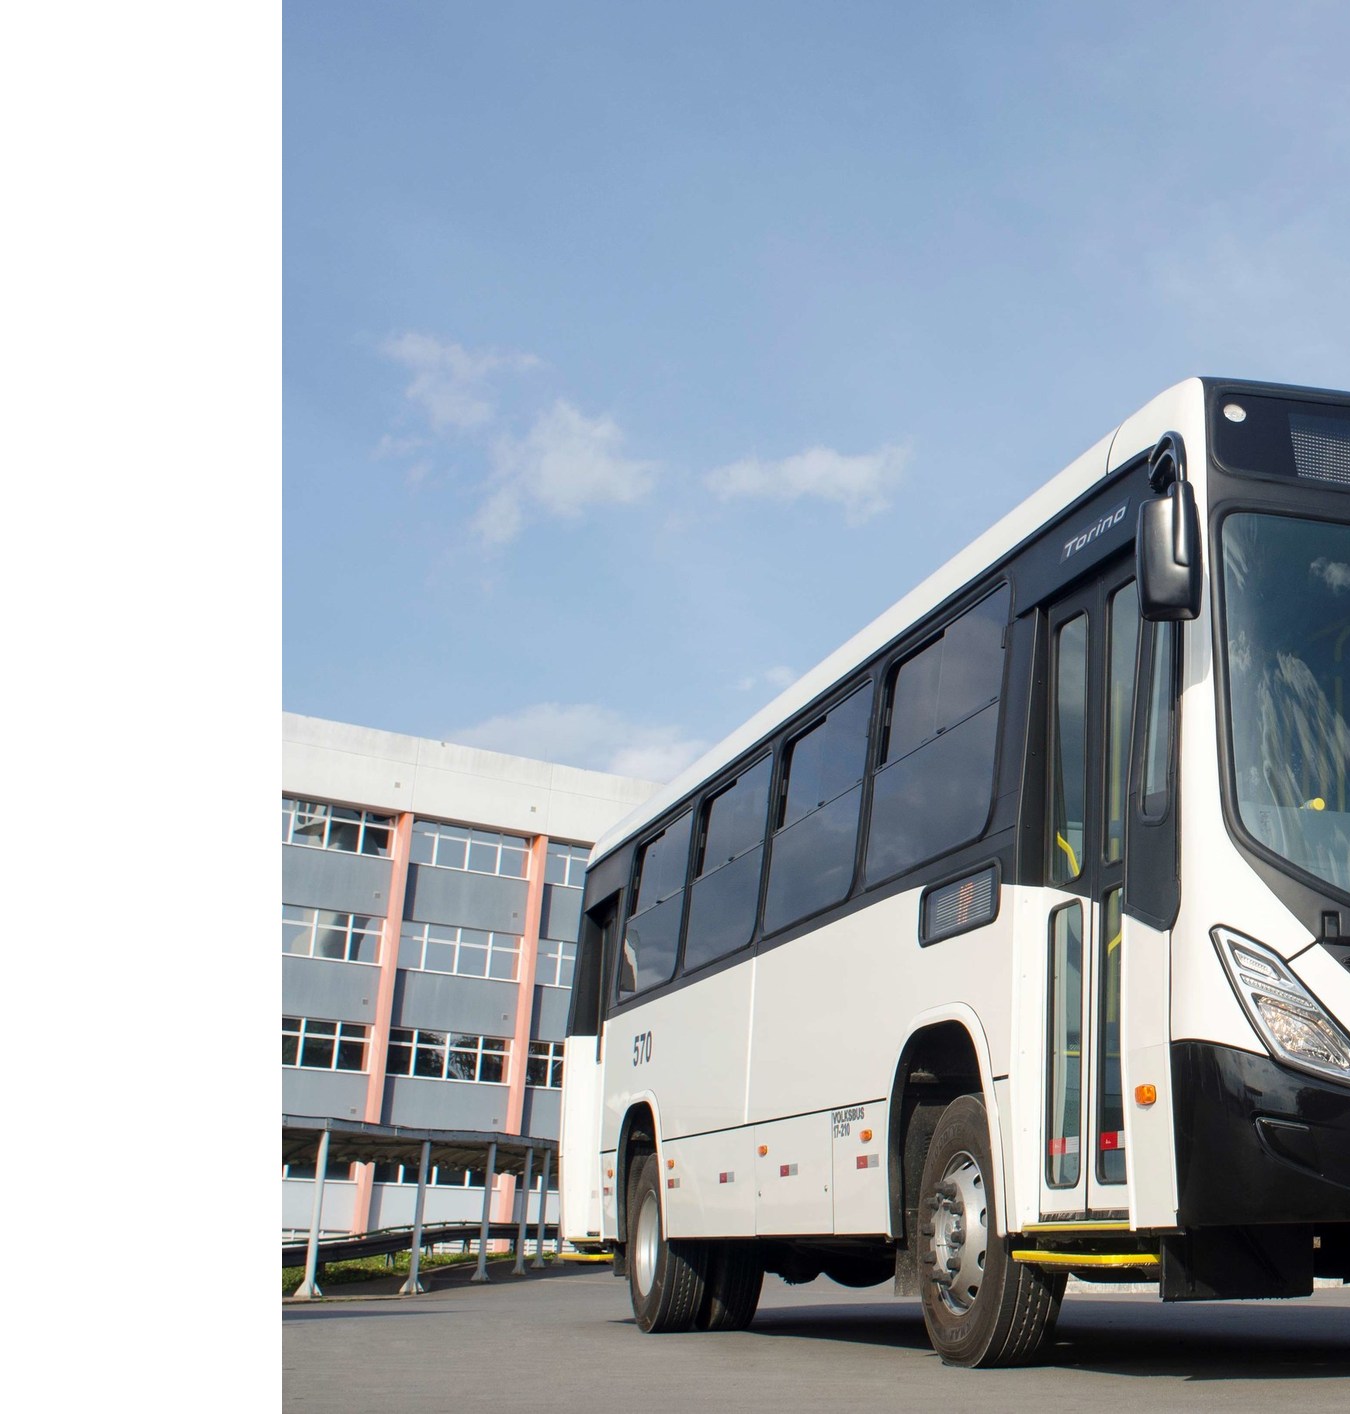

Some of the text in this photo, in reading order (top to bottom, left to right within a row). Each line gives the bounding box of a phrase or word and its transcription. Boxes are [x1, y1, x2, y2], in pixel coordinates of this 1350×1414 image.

[1064, 505, 1127, 558] Torino
[633, 1030, 653, 1067] 570
[832, 1107, 865, 1124] VOLKSBUS
[833, 1123, 851, 1139] 17-210
